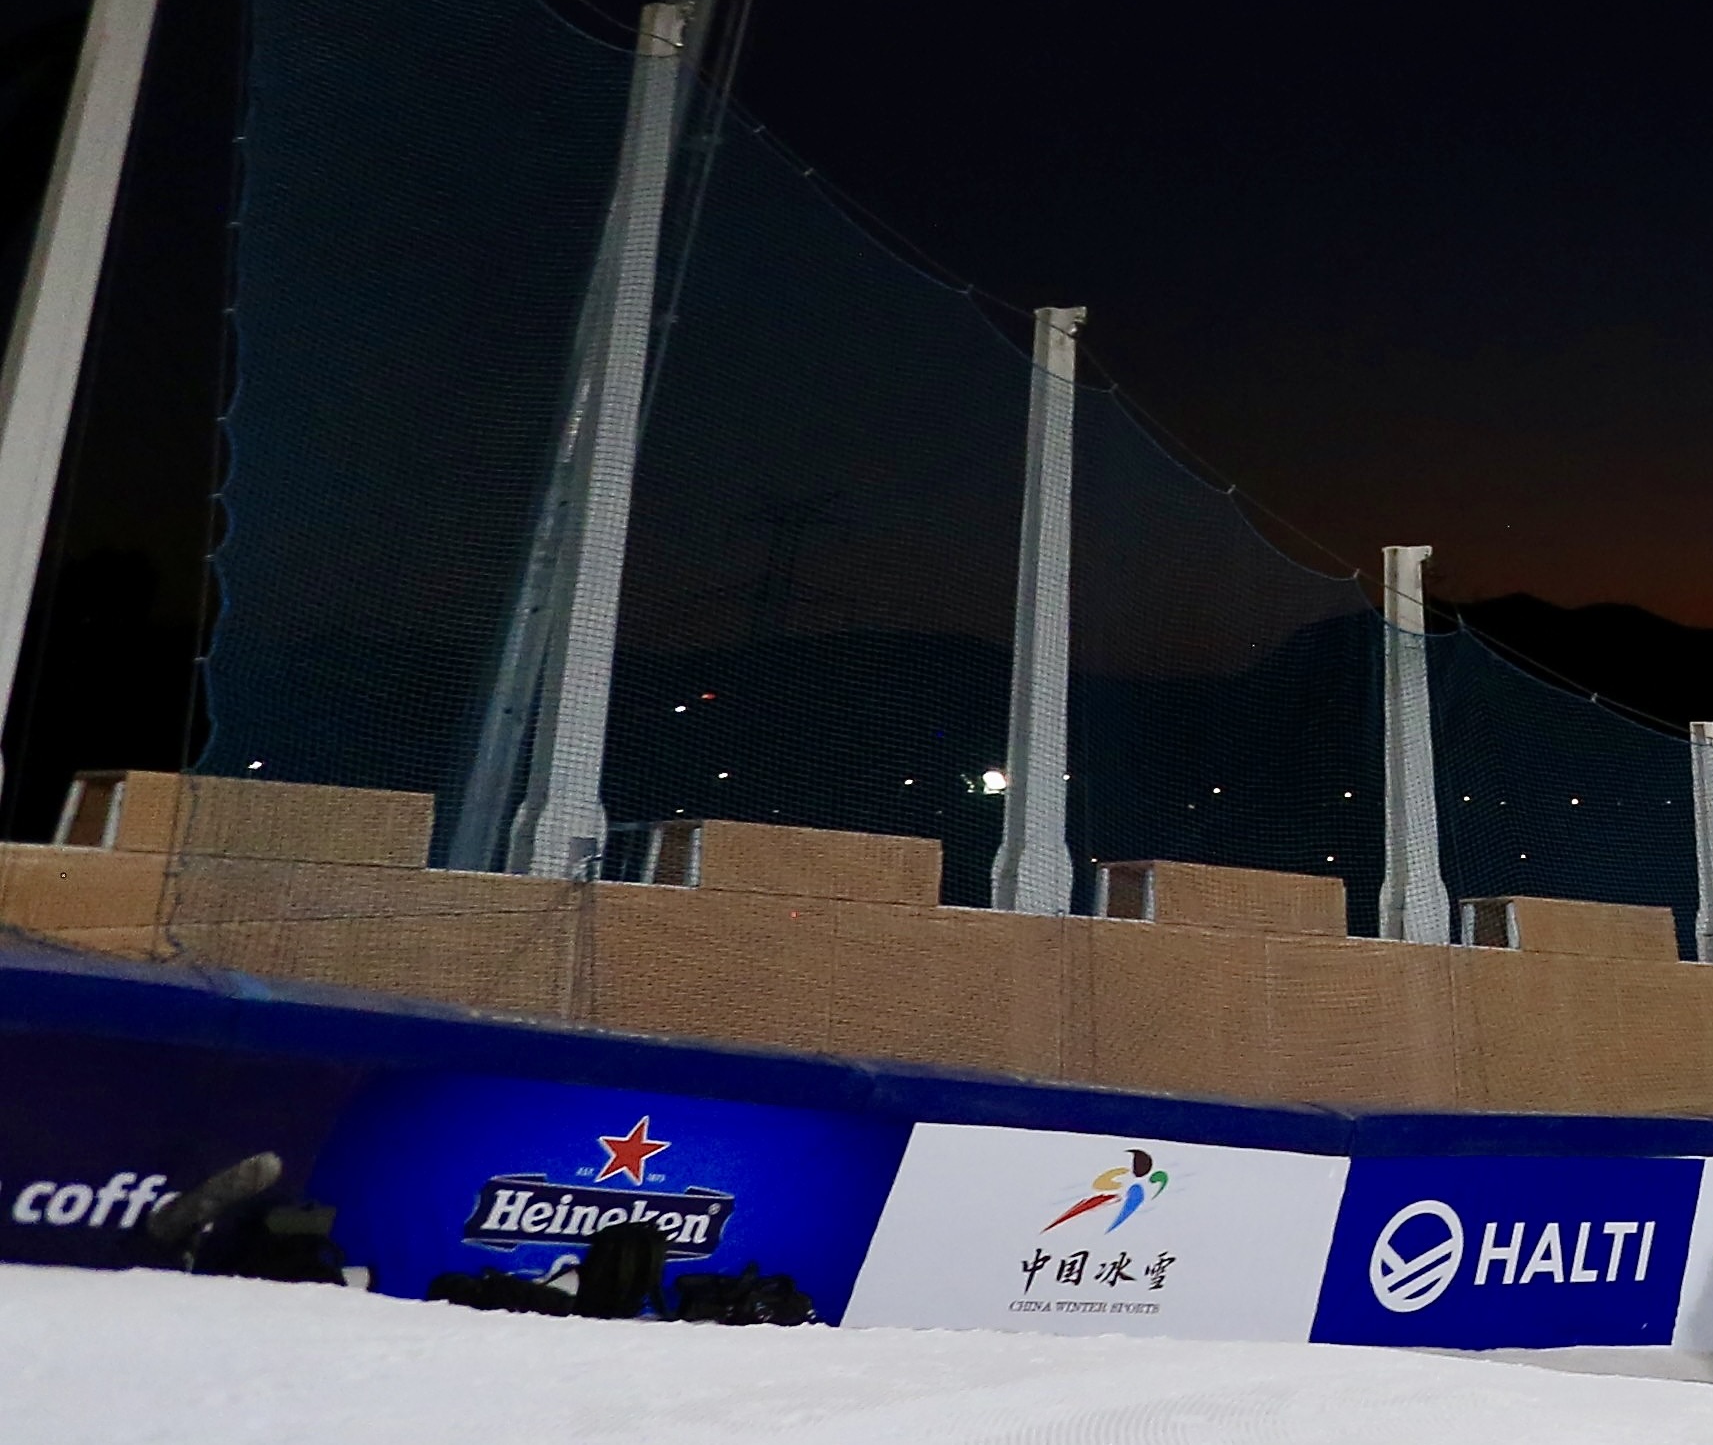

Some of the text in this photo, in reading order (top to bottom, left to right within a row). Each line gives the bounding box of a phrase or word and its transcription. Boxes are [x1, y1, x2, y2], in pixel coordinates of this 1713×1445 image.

[12, 1172, 182, 1228] coff
[1021, 1248, 1176, 1295] 中国冰雪
[1474, 1221, 1656, 1286] HALTI
[1009, 1299, 1161, 1315] CHINA WINTER SPORTS
